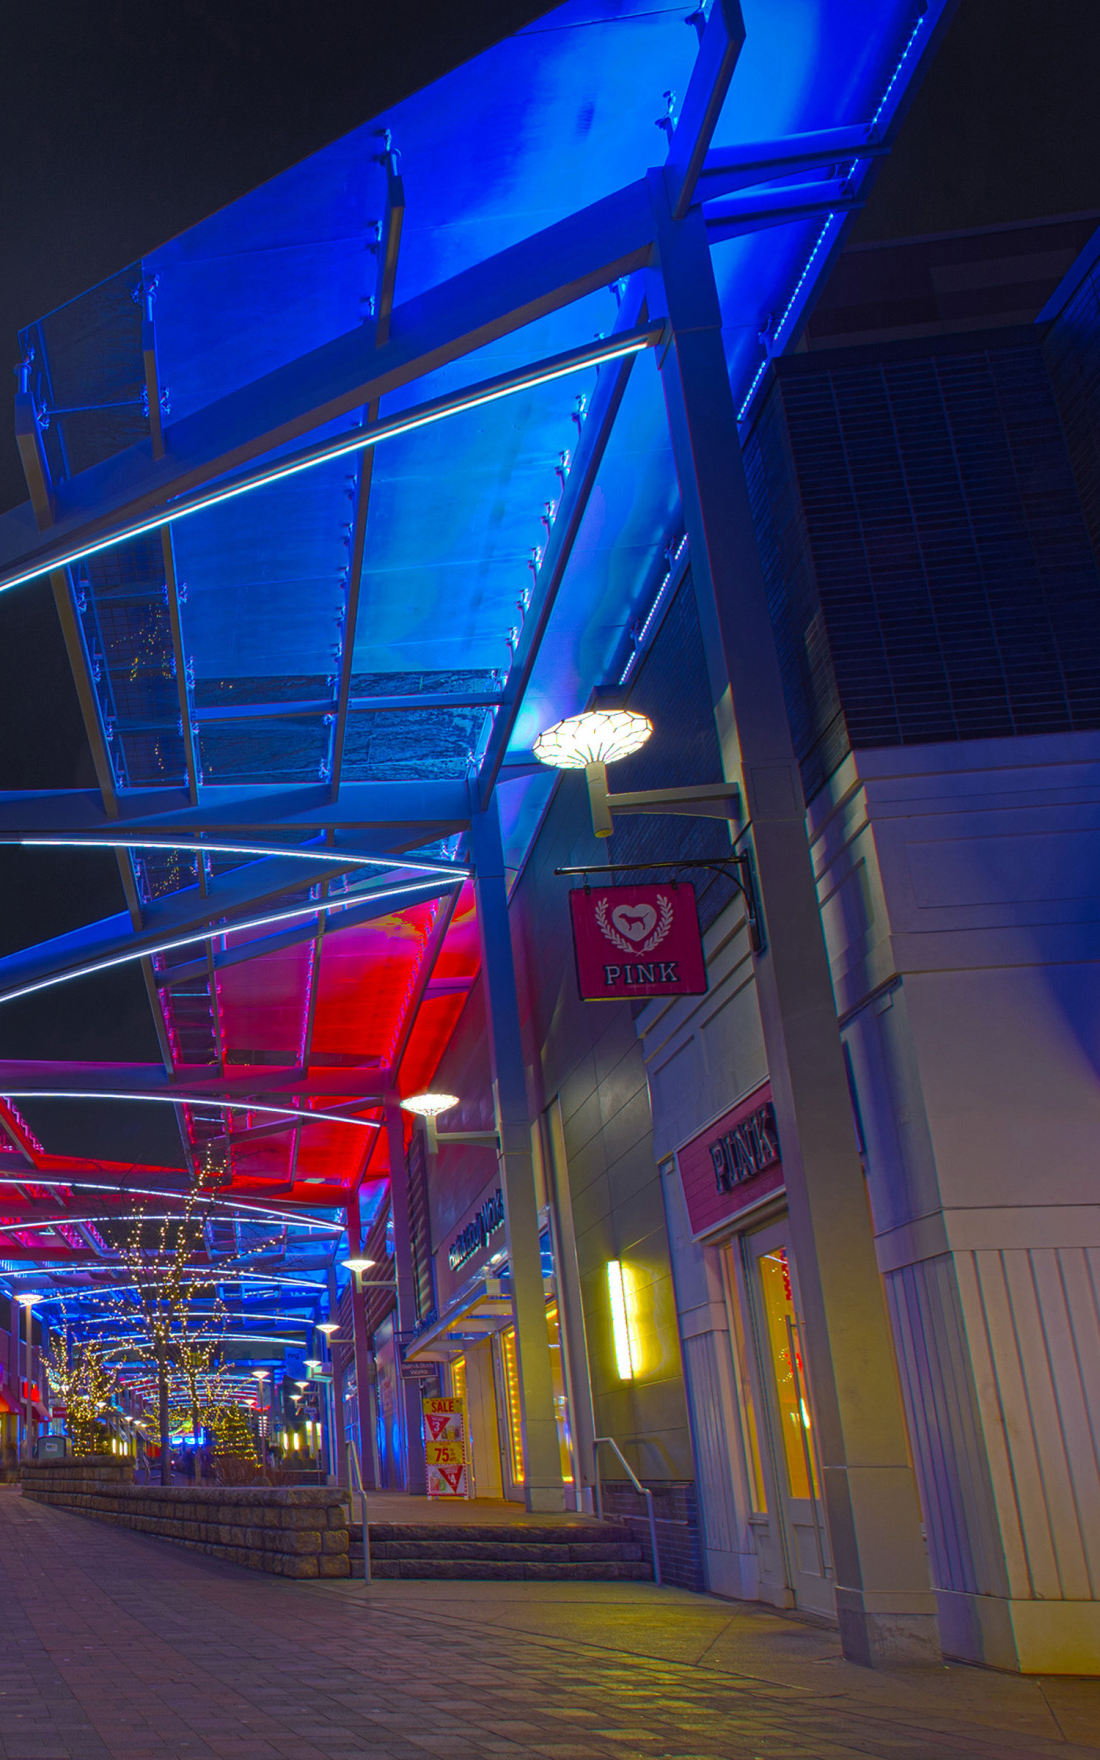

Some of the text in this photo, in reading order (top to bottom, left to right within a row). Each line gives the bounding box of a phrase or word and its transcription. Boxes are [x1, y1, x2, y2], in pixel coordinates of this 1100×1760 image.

[604, 962, 678, 985] PINK
[709, 1102, 780, 1196] PINK
[431, 1401, 454, 1413] SALE
